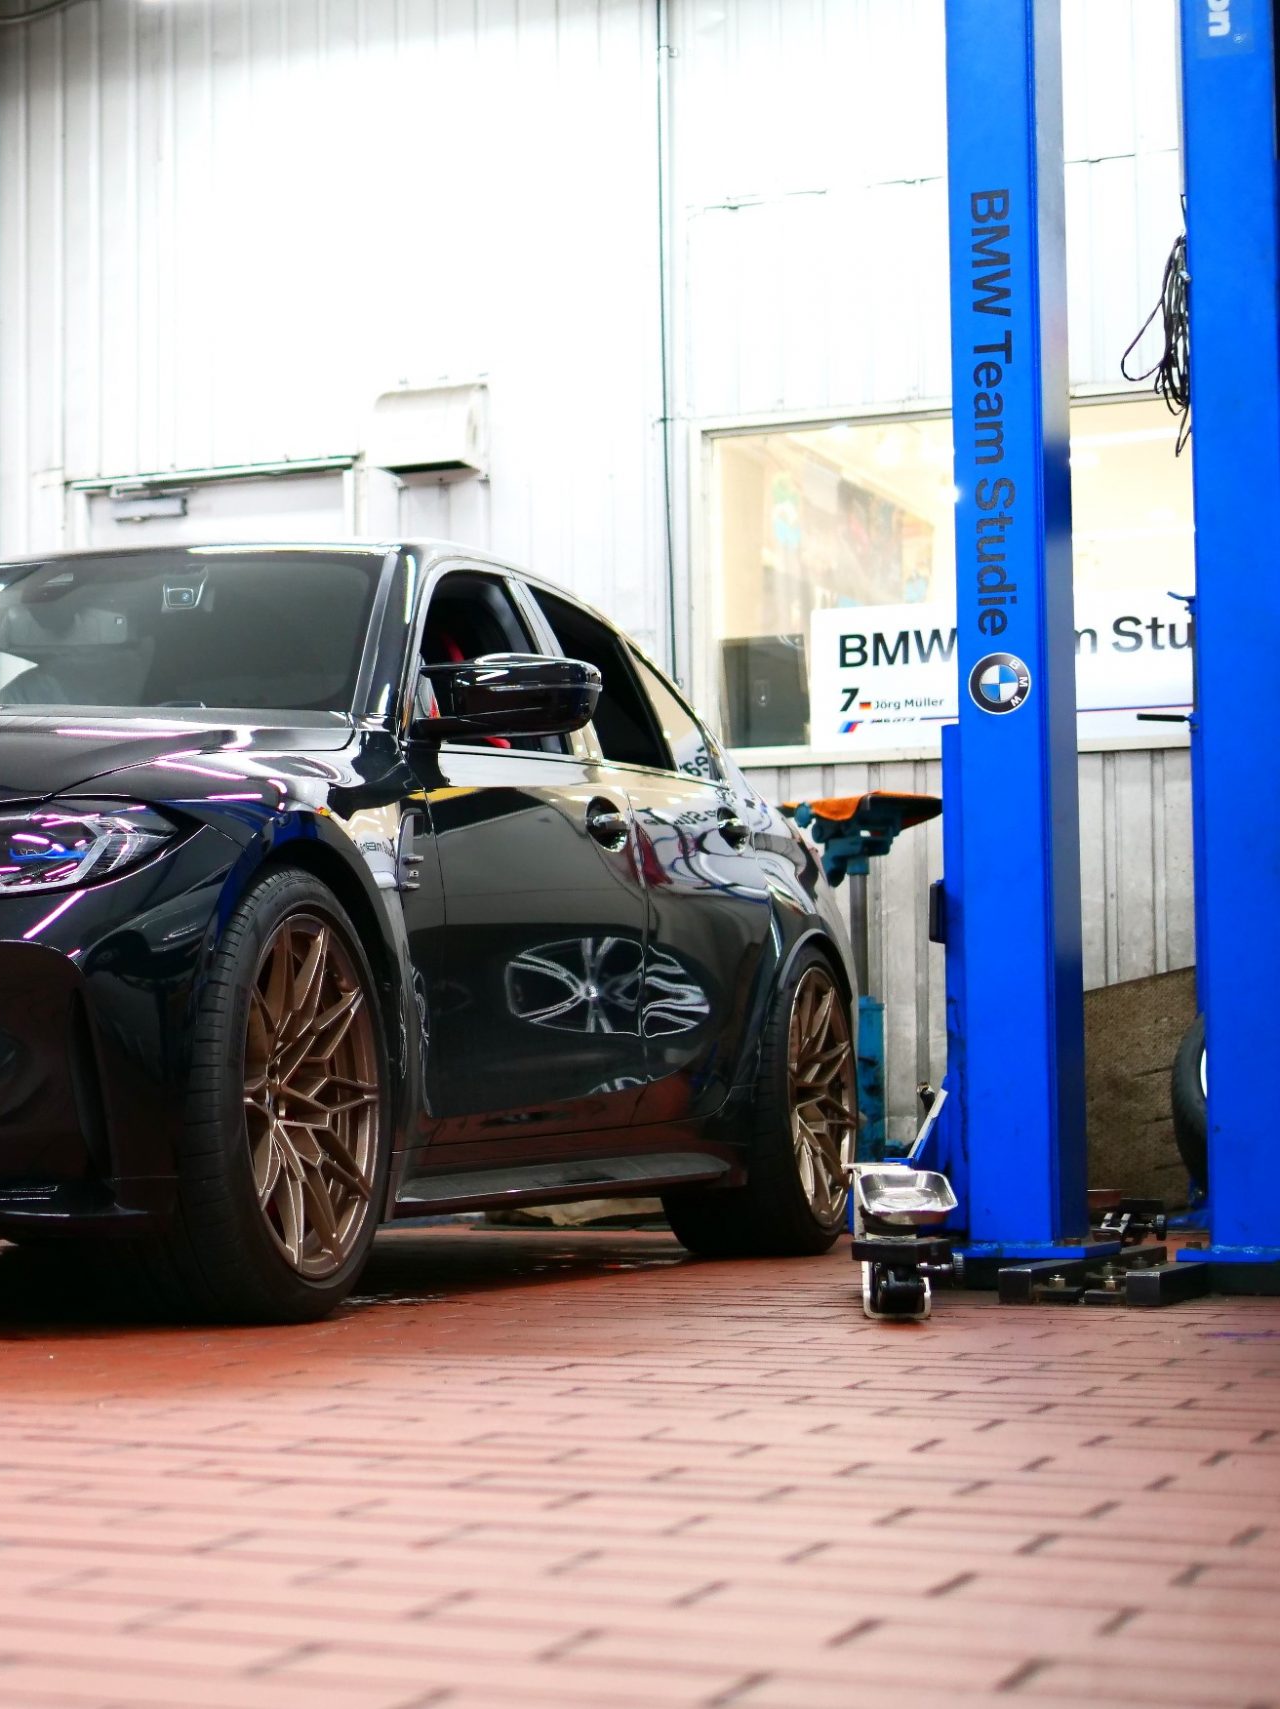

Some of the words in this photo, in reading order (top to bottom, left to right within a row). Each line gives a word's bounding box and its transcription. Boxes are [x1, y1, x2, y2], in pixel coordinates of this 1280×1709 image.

[970, 188, 1012, 317] BMW
[972, 329, 1013, 465] Team
[975, 476, 1018, 637] Studie
[838, 627, 957, 669] BMW
[1008, 659, 1029, 707] BMW
[839, 687, 860, 712] 7
[874, 699, 901, 710] Jörg
[904, 697, 945, 708] Müller
